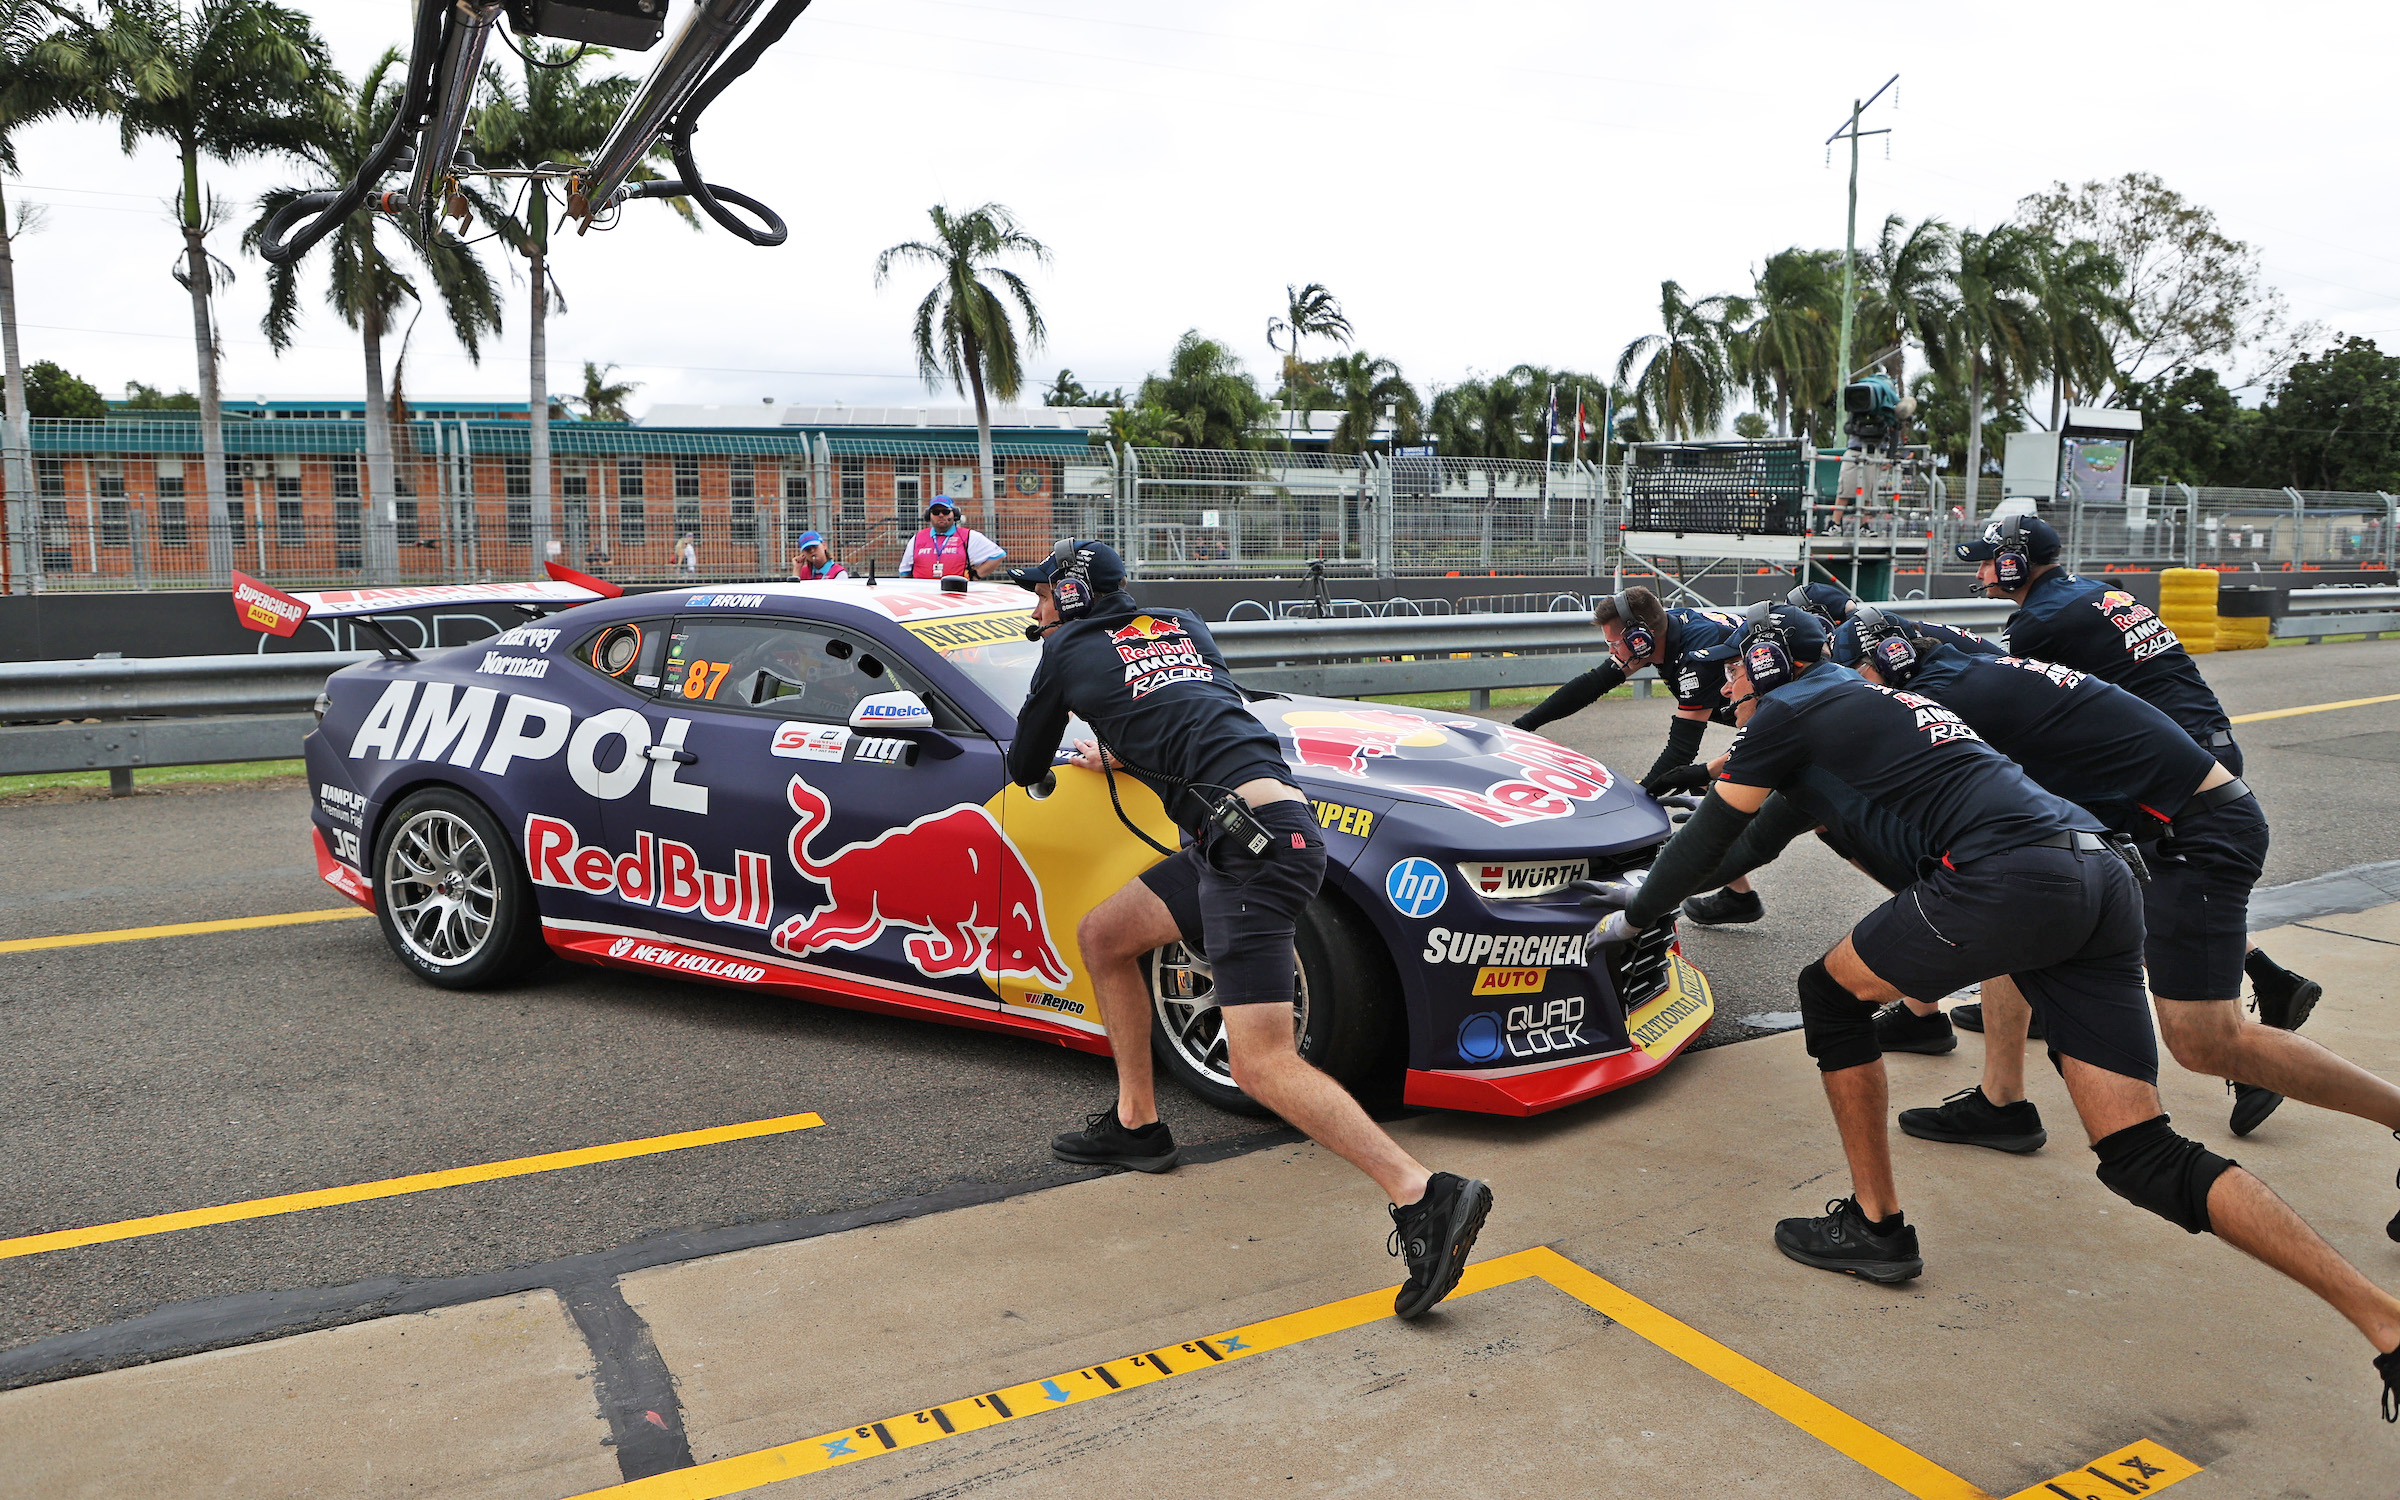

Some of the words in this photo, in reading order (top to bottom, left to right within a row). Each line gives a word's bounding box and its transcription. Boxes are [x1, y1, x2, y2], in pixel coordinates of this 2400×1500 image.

[918, 547, 932, 555] PIT
[234, 582, 303, 622] SUPERCHEAP
[358, 582, 543, 601] AMPLIFY
[710, 594, 766, 608] BROWN
[250, 608, 275, 624] AUTO
[911, 615, 1033, 646] NATIONA
[496, 625, 562, 653] Harvey
[2124, 616, 2168, 650] AMP
[2133, 630, 2178, 661] RACIN
[475, 651, 550, 679] Norman
[1116, 641, 1161, 664] Red
[1156, 637, 1198, 657] Bull
[683, 660, 731, 700] 87
[1124, 653, 1213, 683] AMPOL
[1132, 668, 1214, 699] RACING
[862, 704, 930, 717] ACDelco
[347, 680, 709, 815] AMPOL
[854, 737, 906, 760] nti
[328, 784, 368, 813] AMPLIFY
[1386, 752, 1608, 828] Red
[321, 799, 351, 823] Premium
[1310, 799, 1374, 838] UPER
[524, 813, 655, 905] Red
[656, 837, 775, 930] Bull
[1506, 863, 1585, 889] WÜRTH
[1393, 856, 1444, 918] hp
[630, 944, 677, 965] NEW
[673, 953, 766, 982] HOLLAND
[1481, 970, 1540, 989] AUTO
[1041, 992, 1085, 1015] Repco
[1505, 996, 1586, 1032] QUAD
[1631, 996, 1701, 1049] NATIONAL
[1506, 1021, 1590, 1058] LOCK
[855, 1426, 871, 1439] 3
[913, 1411, 930, 1424] 2
[1129, 1356, 1146, 1367] 2
[1180, 1343, 1197, 1353] 3
[2126, 1476, 2151, 1491] 3
